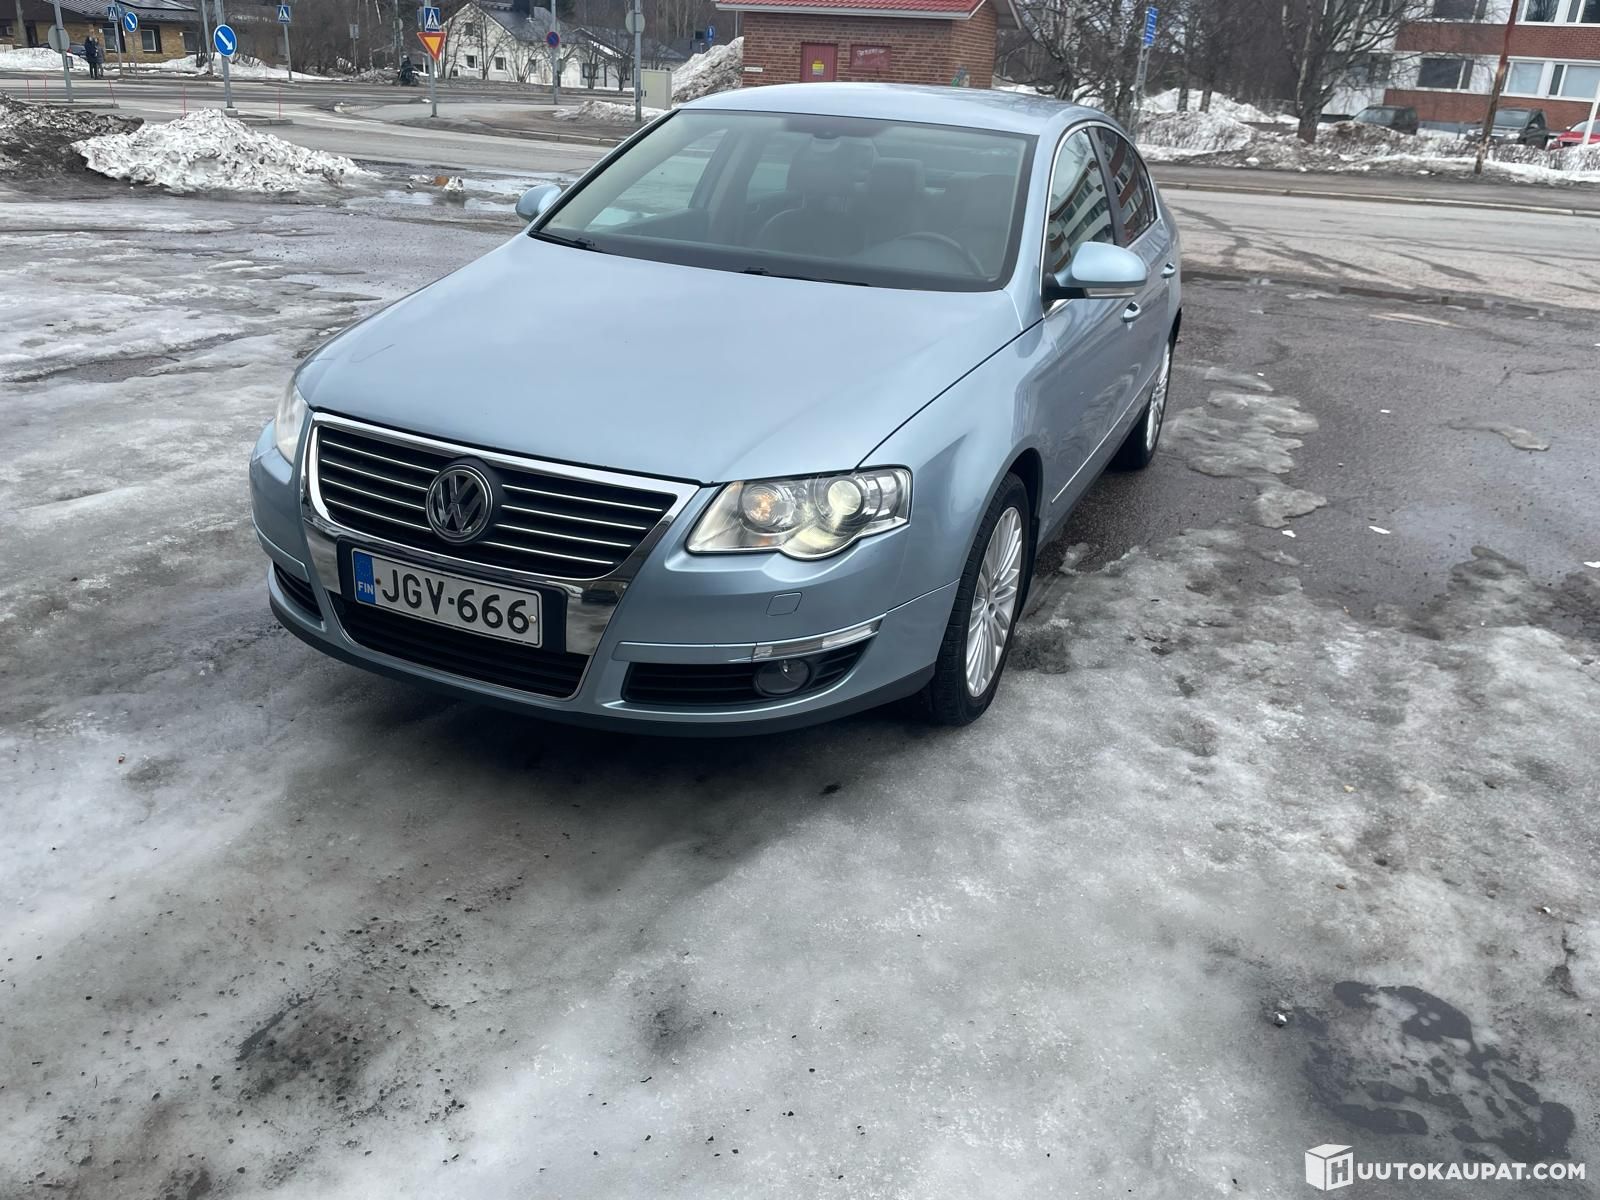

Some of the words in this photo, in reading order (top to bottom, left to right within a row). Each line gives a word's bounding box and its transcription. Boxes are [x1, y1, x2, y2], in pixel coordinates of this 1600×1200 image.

[428, 467, 488, 537] VW
[357, 580, 374, 596] FIN
[381, 568, 530, 635] JGV-666
